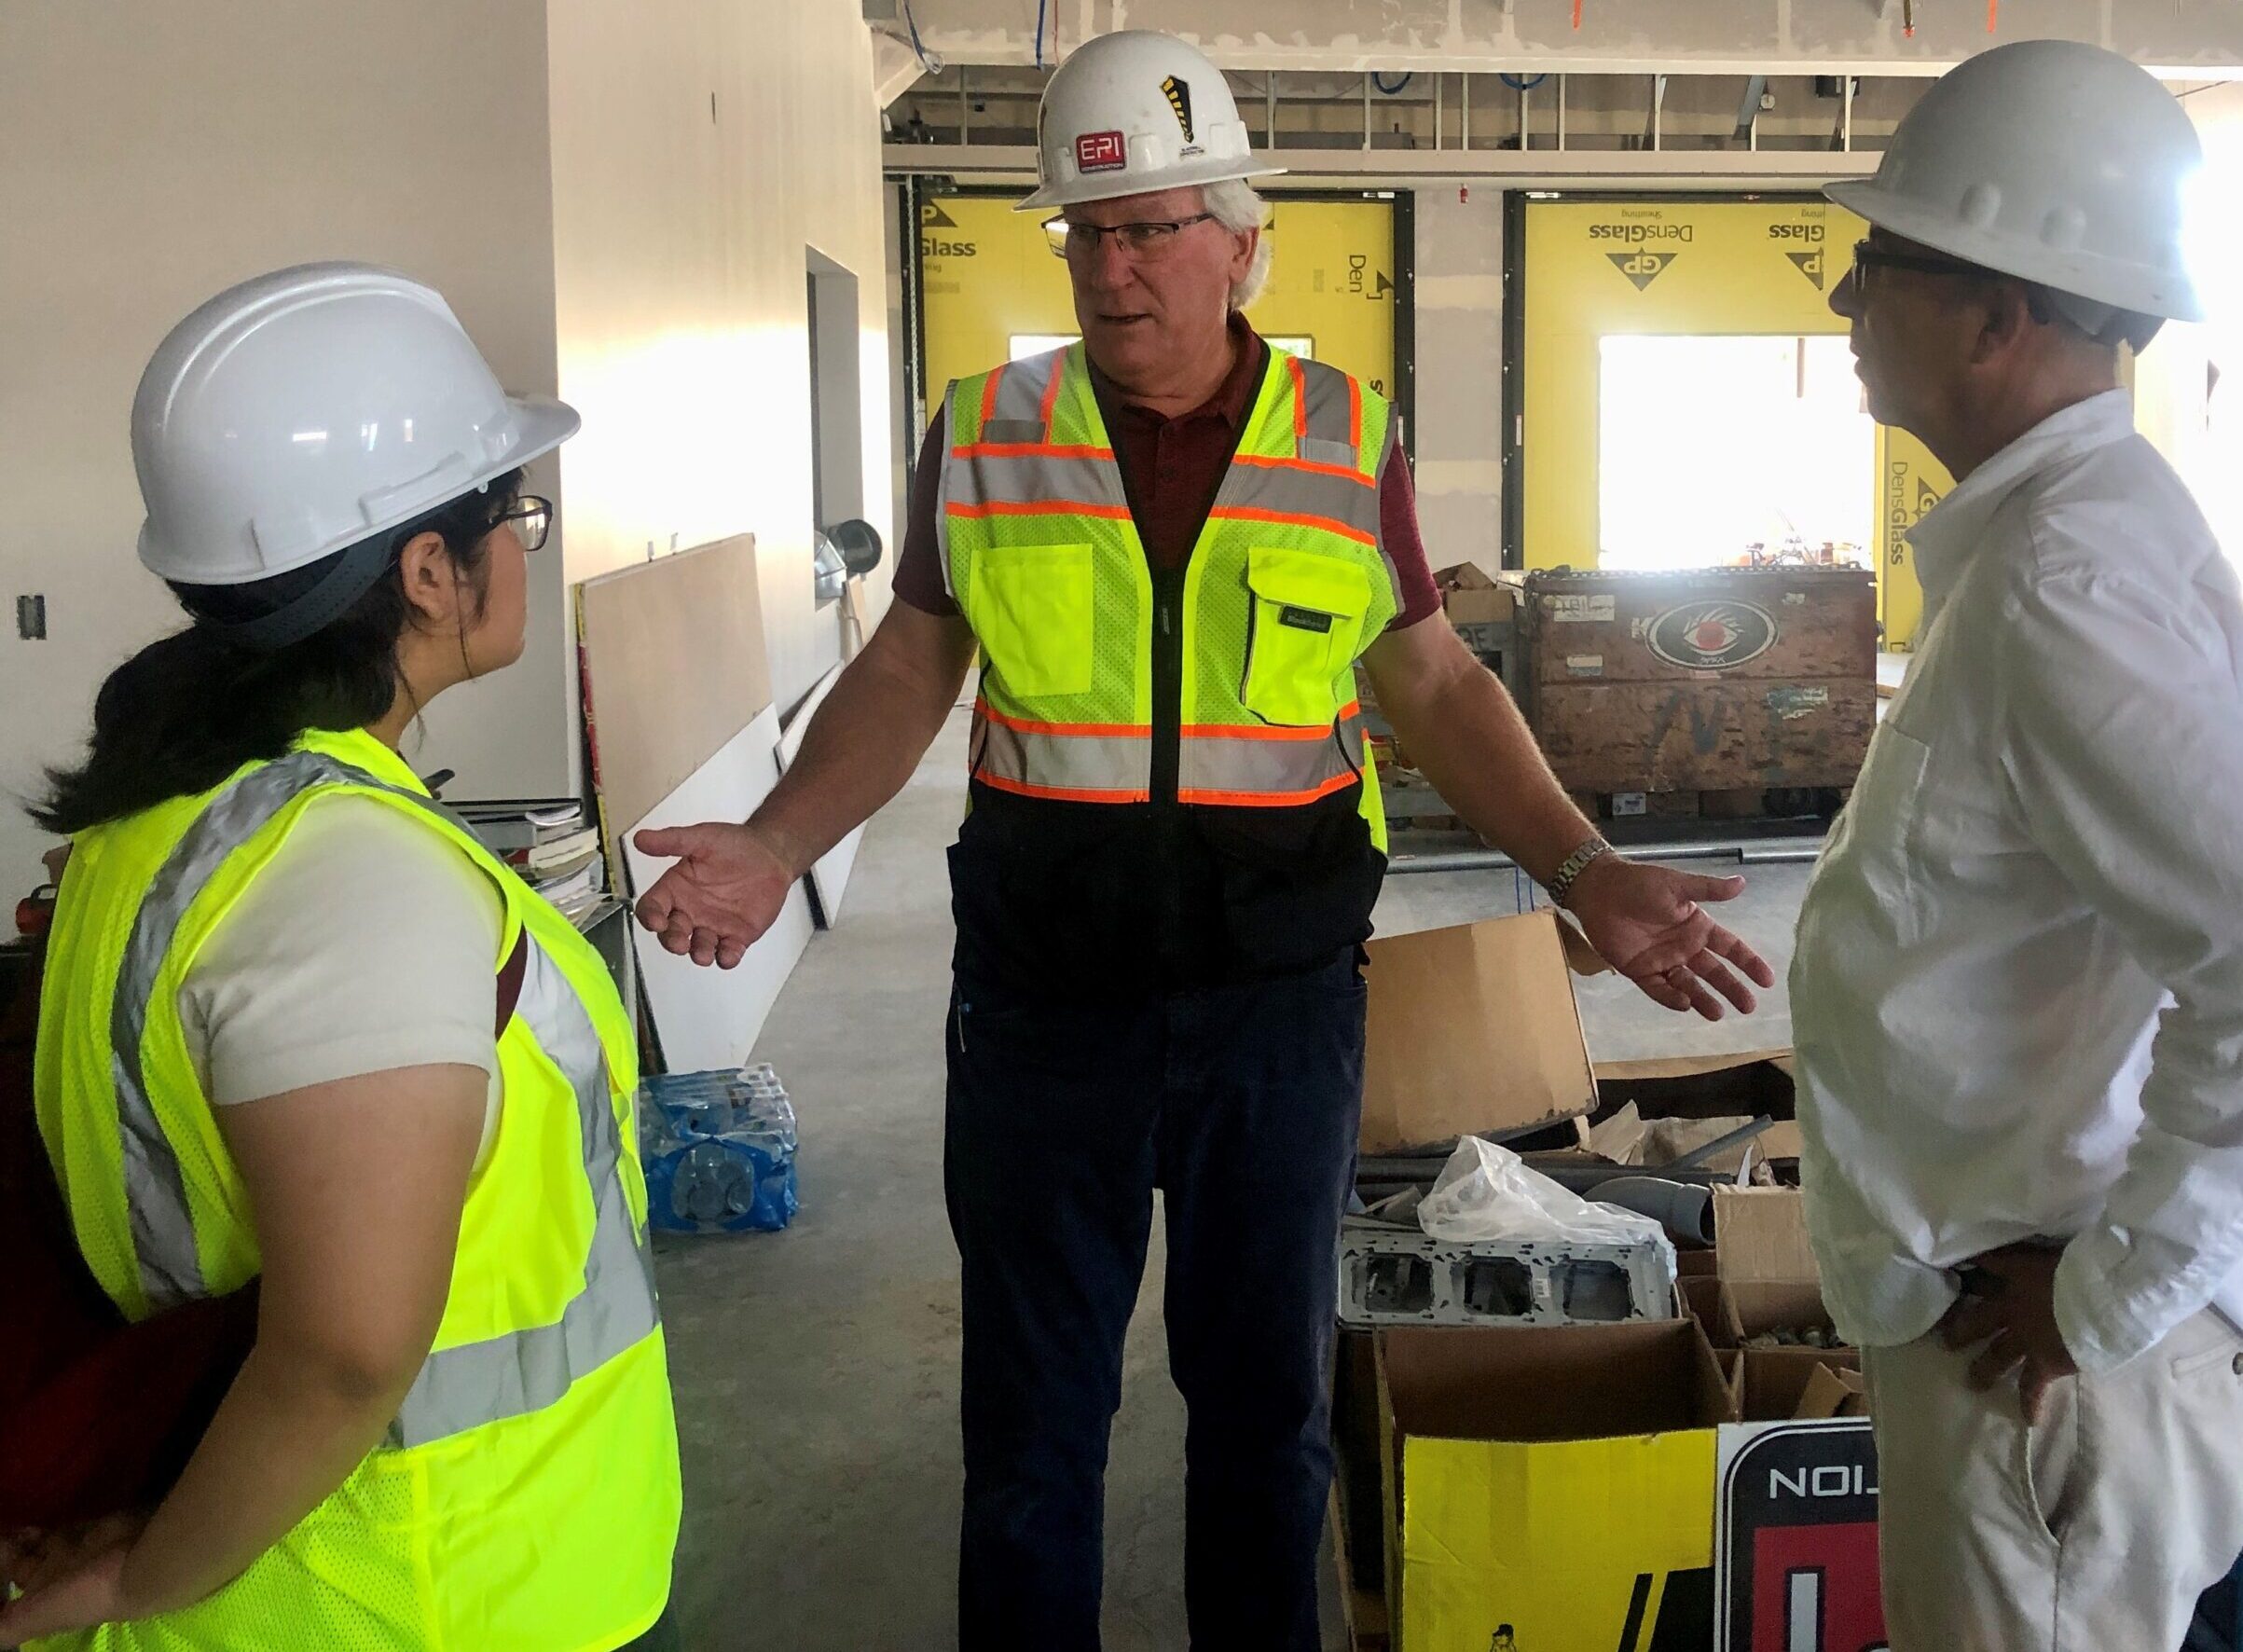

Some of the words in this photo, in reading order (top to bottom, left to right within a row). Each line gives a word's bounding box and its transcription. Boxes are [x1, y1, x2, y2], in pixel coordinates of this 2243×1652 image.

[1080, 136, 1120, 160] EPI
[1589, 225, 1693, 242] DensGlass
[1623, 255, 1662, 275] GP
[1890, 461, 1908, 567] DensGlass
